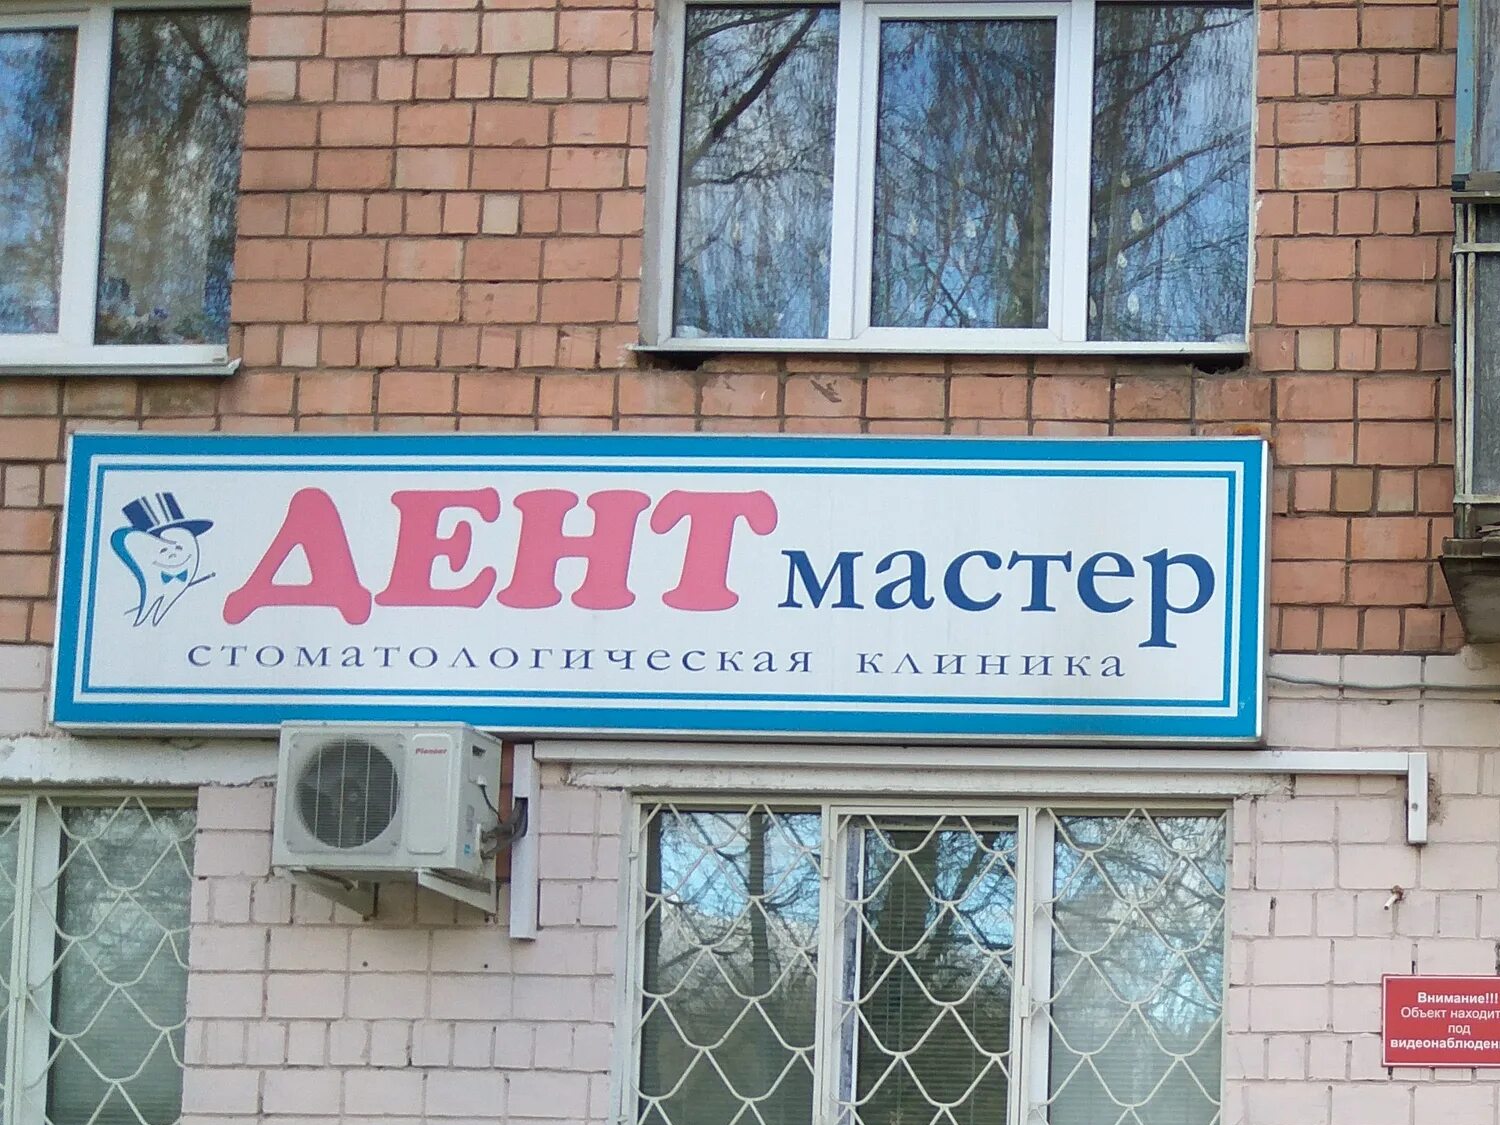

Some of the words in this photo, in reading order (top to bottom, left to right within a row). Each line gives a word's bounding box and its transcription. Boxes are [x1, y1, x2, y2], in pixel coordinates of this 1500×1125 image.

[223, 487, 778, 625] ДЕНТ
[778, 547, 1216, 649] мастер
[187, 644, 813, 673] стоматологическая
[856, 652, 1126, 678] клиника
[1417, 992, 1499, 1004] Внимание!!!
[1400, 1007, 1446, 1019] Объект
[1448, 1024, 1471, 1035] под
